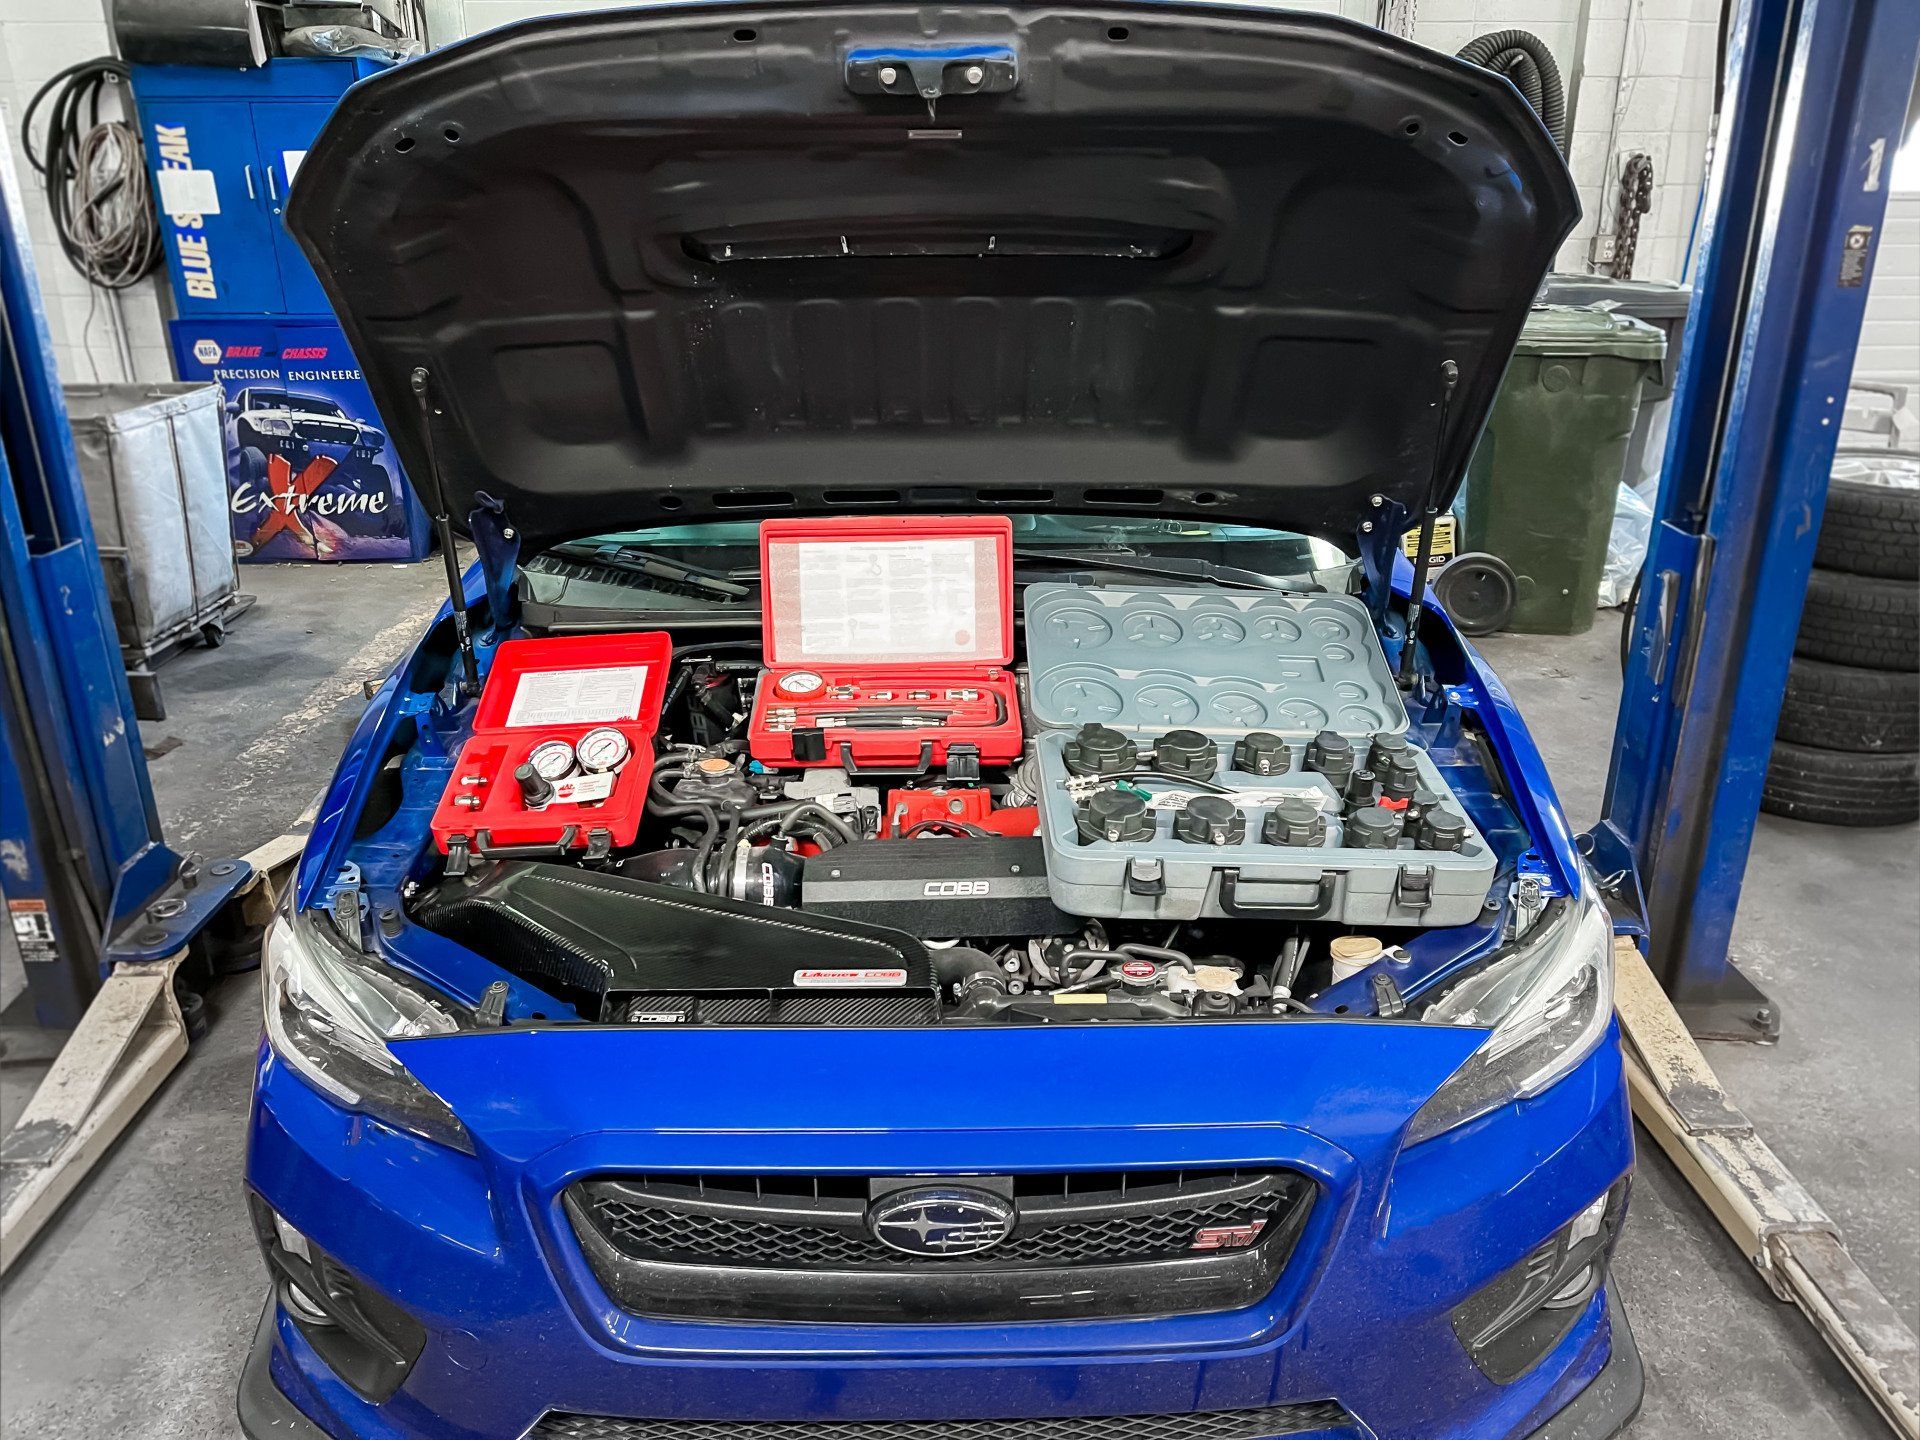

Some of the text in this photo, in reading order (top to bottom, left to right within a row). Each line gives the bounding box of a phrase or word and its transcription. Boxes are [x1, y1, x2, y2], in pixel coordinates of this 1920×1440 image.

[1863, 138, 1886, 192] 1
[155, 123, 217, 299] BLUE SEAK
[198, 346, 218, 357] NAPA
[225, 346, 328, 360] BRAKE CHASSIS
[213, 369, 361, 381] PRECISION ENGINEERE
[230, 481, 389, 515] Extreme
[923, 881, 990, 896] COBB
